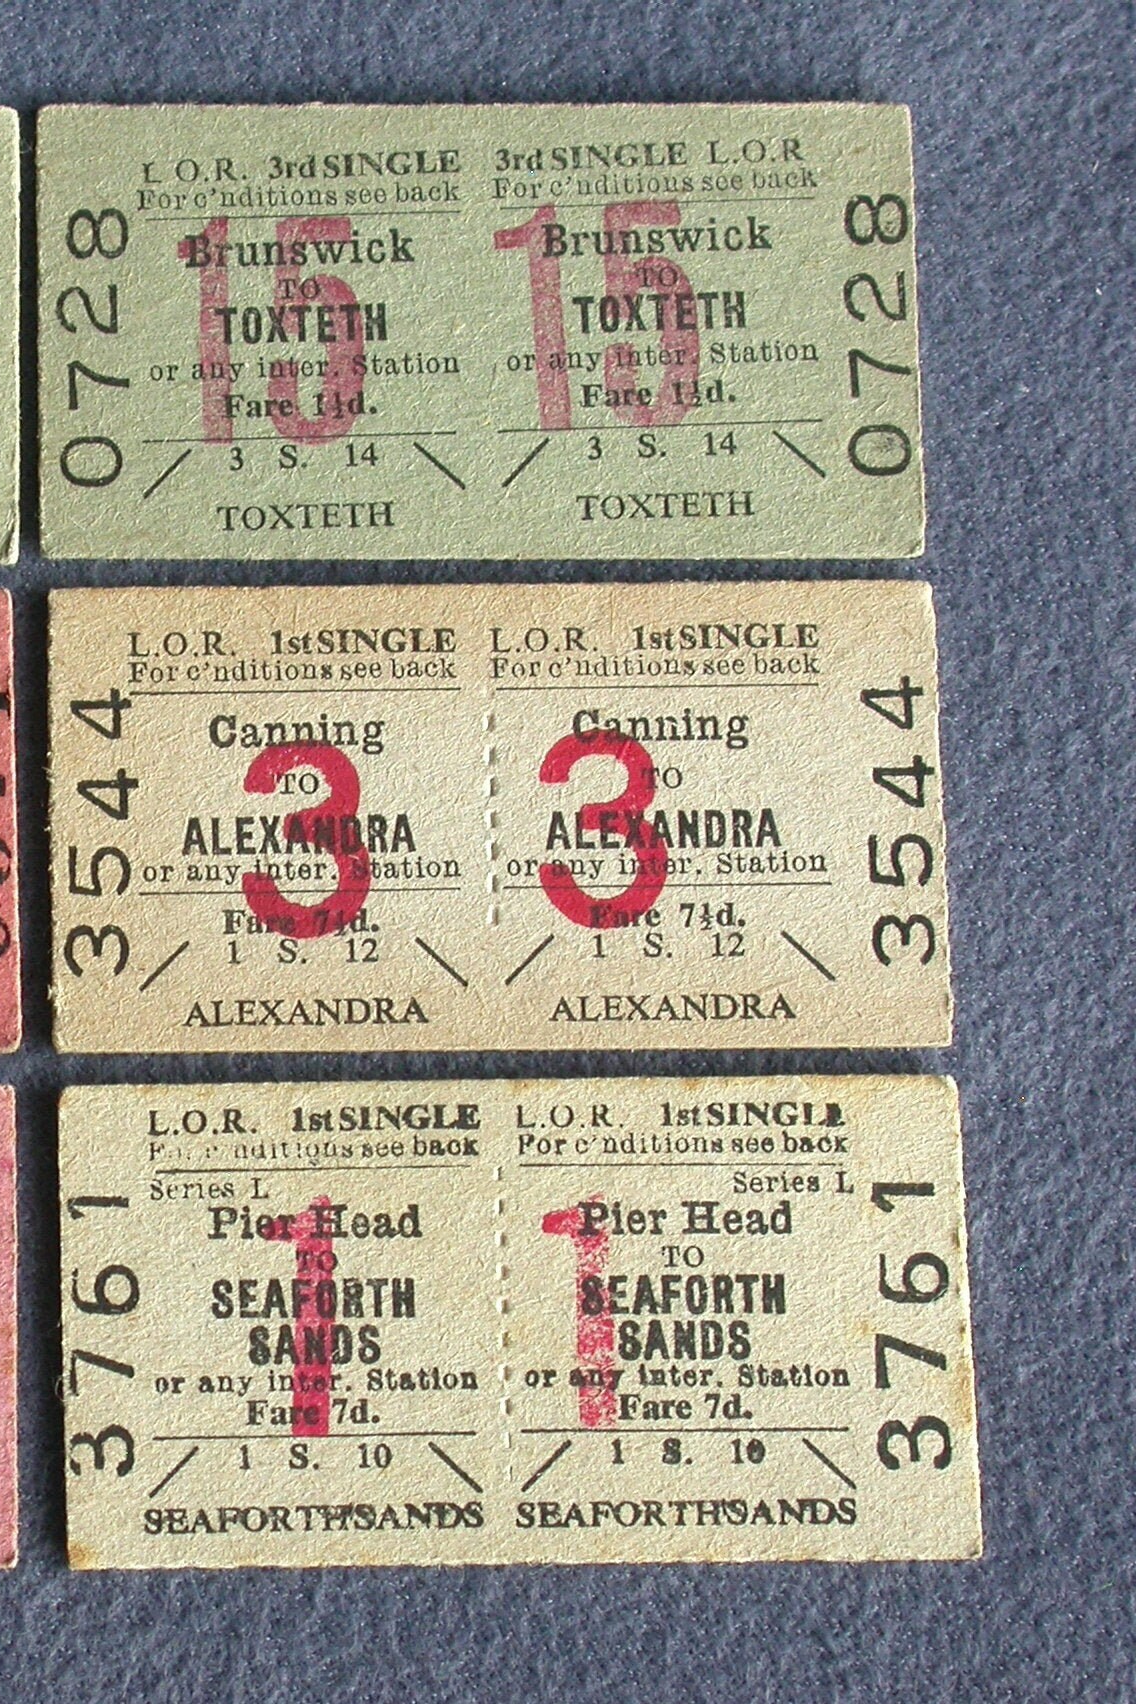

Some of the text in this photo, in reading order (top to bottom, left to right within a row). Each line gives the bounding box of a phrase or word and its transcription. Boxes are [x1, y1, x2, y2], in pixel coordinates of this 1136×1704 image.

[323, 150, 460, 175] SINGLE
[184, 229, 415, 268] Brunswick
[541, 217, 771, 258] Brunswick
[215, 304, 388, 343] TOXTETH
[494, 200, 699, 430] 15
[572, 292, 747, 333] TOXTETH
[55, 208, 129, 486] 0728
[177, 217, 365, 446] 15
[844, 193, 912, 476] 0728
[150, 354, 460, 380] or Station
[229, 444, 377, 470] 3 S. 14
[217, 503, 395, 531] TOXTETH
[576, 491, 754, 520] TOXTETH
[129, 632, 236, 657] L.O.R.
[490, 628, 598, 653] L.O.R.
[679, 624, 819, 649] SINGLE
[703, 657, 744, 674] see
[754, 654, 820, 674] back
[209, 715, 385, 755] Canning
[572, 709, 749, 750] Canning
[277, 774, 318, 795] TO
[63, 689, 139, 977] 3544
[182, 814, 416, 856] ALEXANDRA
[538, 729, 668, 929] 3
[546, 809, 781, 850] ALEXANDRA
[861, 675, 936, 966] 3544
[242, 740, 371, 939] 3
[716, 852, 827, 873] Station
[346, 940, 379, 962] 12
[712, 933, 745, 957] 12
[183, 1000, 428, 1026] ALEXANDRA
[549, 995, 795, 1022] ALEXANDRA
[149, 1110, 257, 1136] L.O.R.
[516, 1104, 623, 1128] L.O.R.
[151, 1179, 269, 1199] Series L
[733, 1172, 854, 1193] Series L
[208, 1204, 422, 1239] Pier Head
[578, 1201, 792, 1237] Pier Head
[212, 1279, 416, 1319] SEAFORTH
[542, 1193, 615, 1426] 1
[579, 1274, 786, 1315] SEAFORTH
[68, 1195, 140, 1476] 3761
[249, 1325, 381, 1365] SANDS
[618, 1320, 751, 1361] SANDS
[871, 1182, 952, 1471] 3761
[737, 1364, 850, 1385] Station
[246, 1400, 380, 1426] Fare 7d.
[618, 1393, 752, 1420] Fare 7d.
